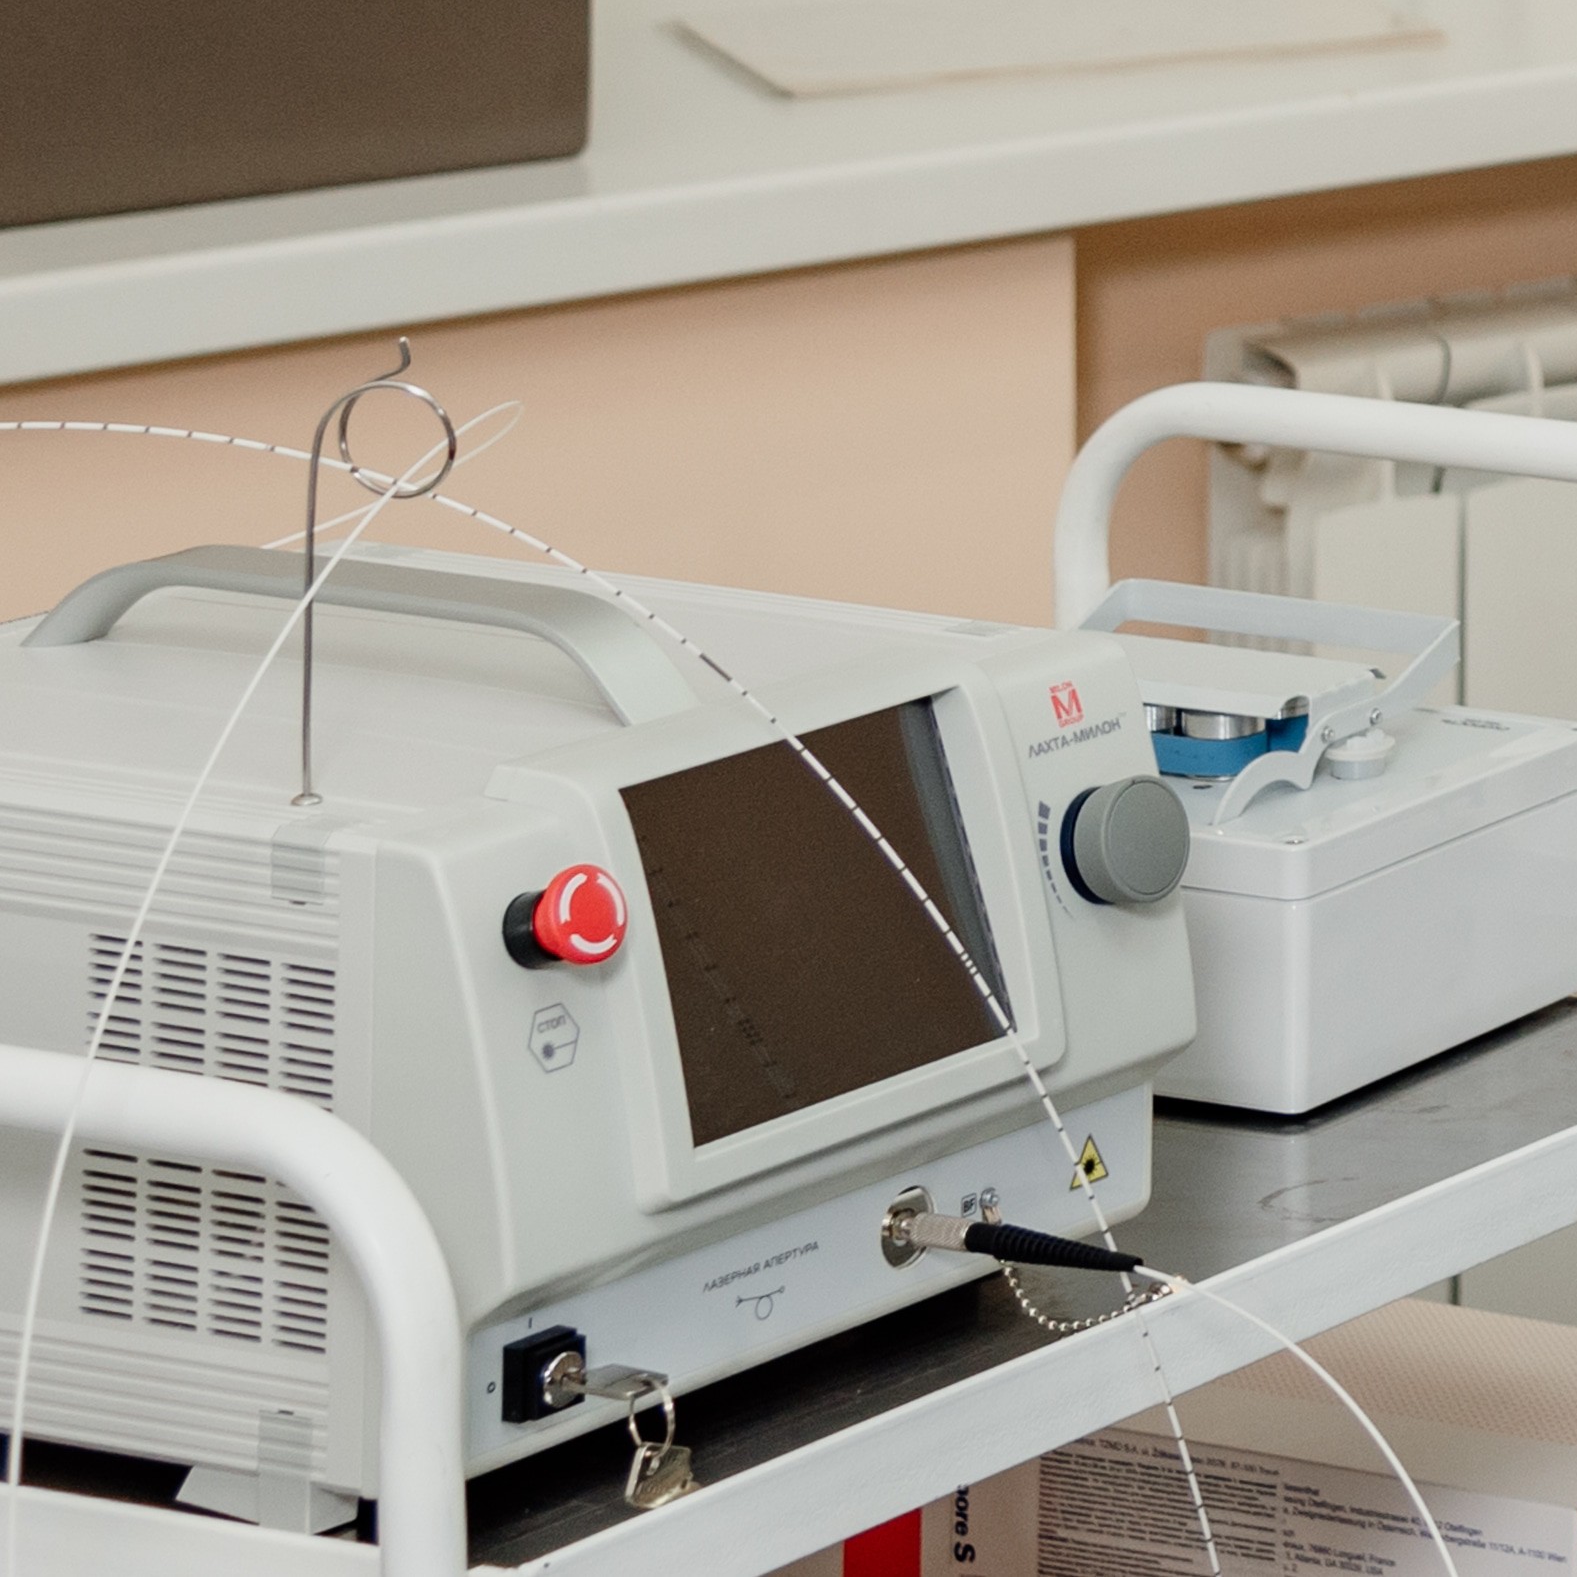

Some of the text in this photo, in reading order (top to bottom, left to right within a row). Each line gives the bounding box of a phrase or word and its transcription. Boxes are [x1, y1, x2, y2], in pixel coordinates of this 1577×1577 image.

[702, 1241, 819, 1294] ЛАЗЕРНАЯ АПЕРТУРА
[954, 1542, 976, 1563] S
